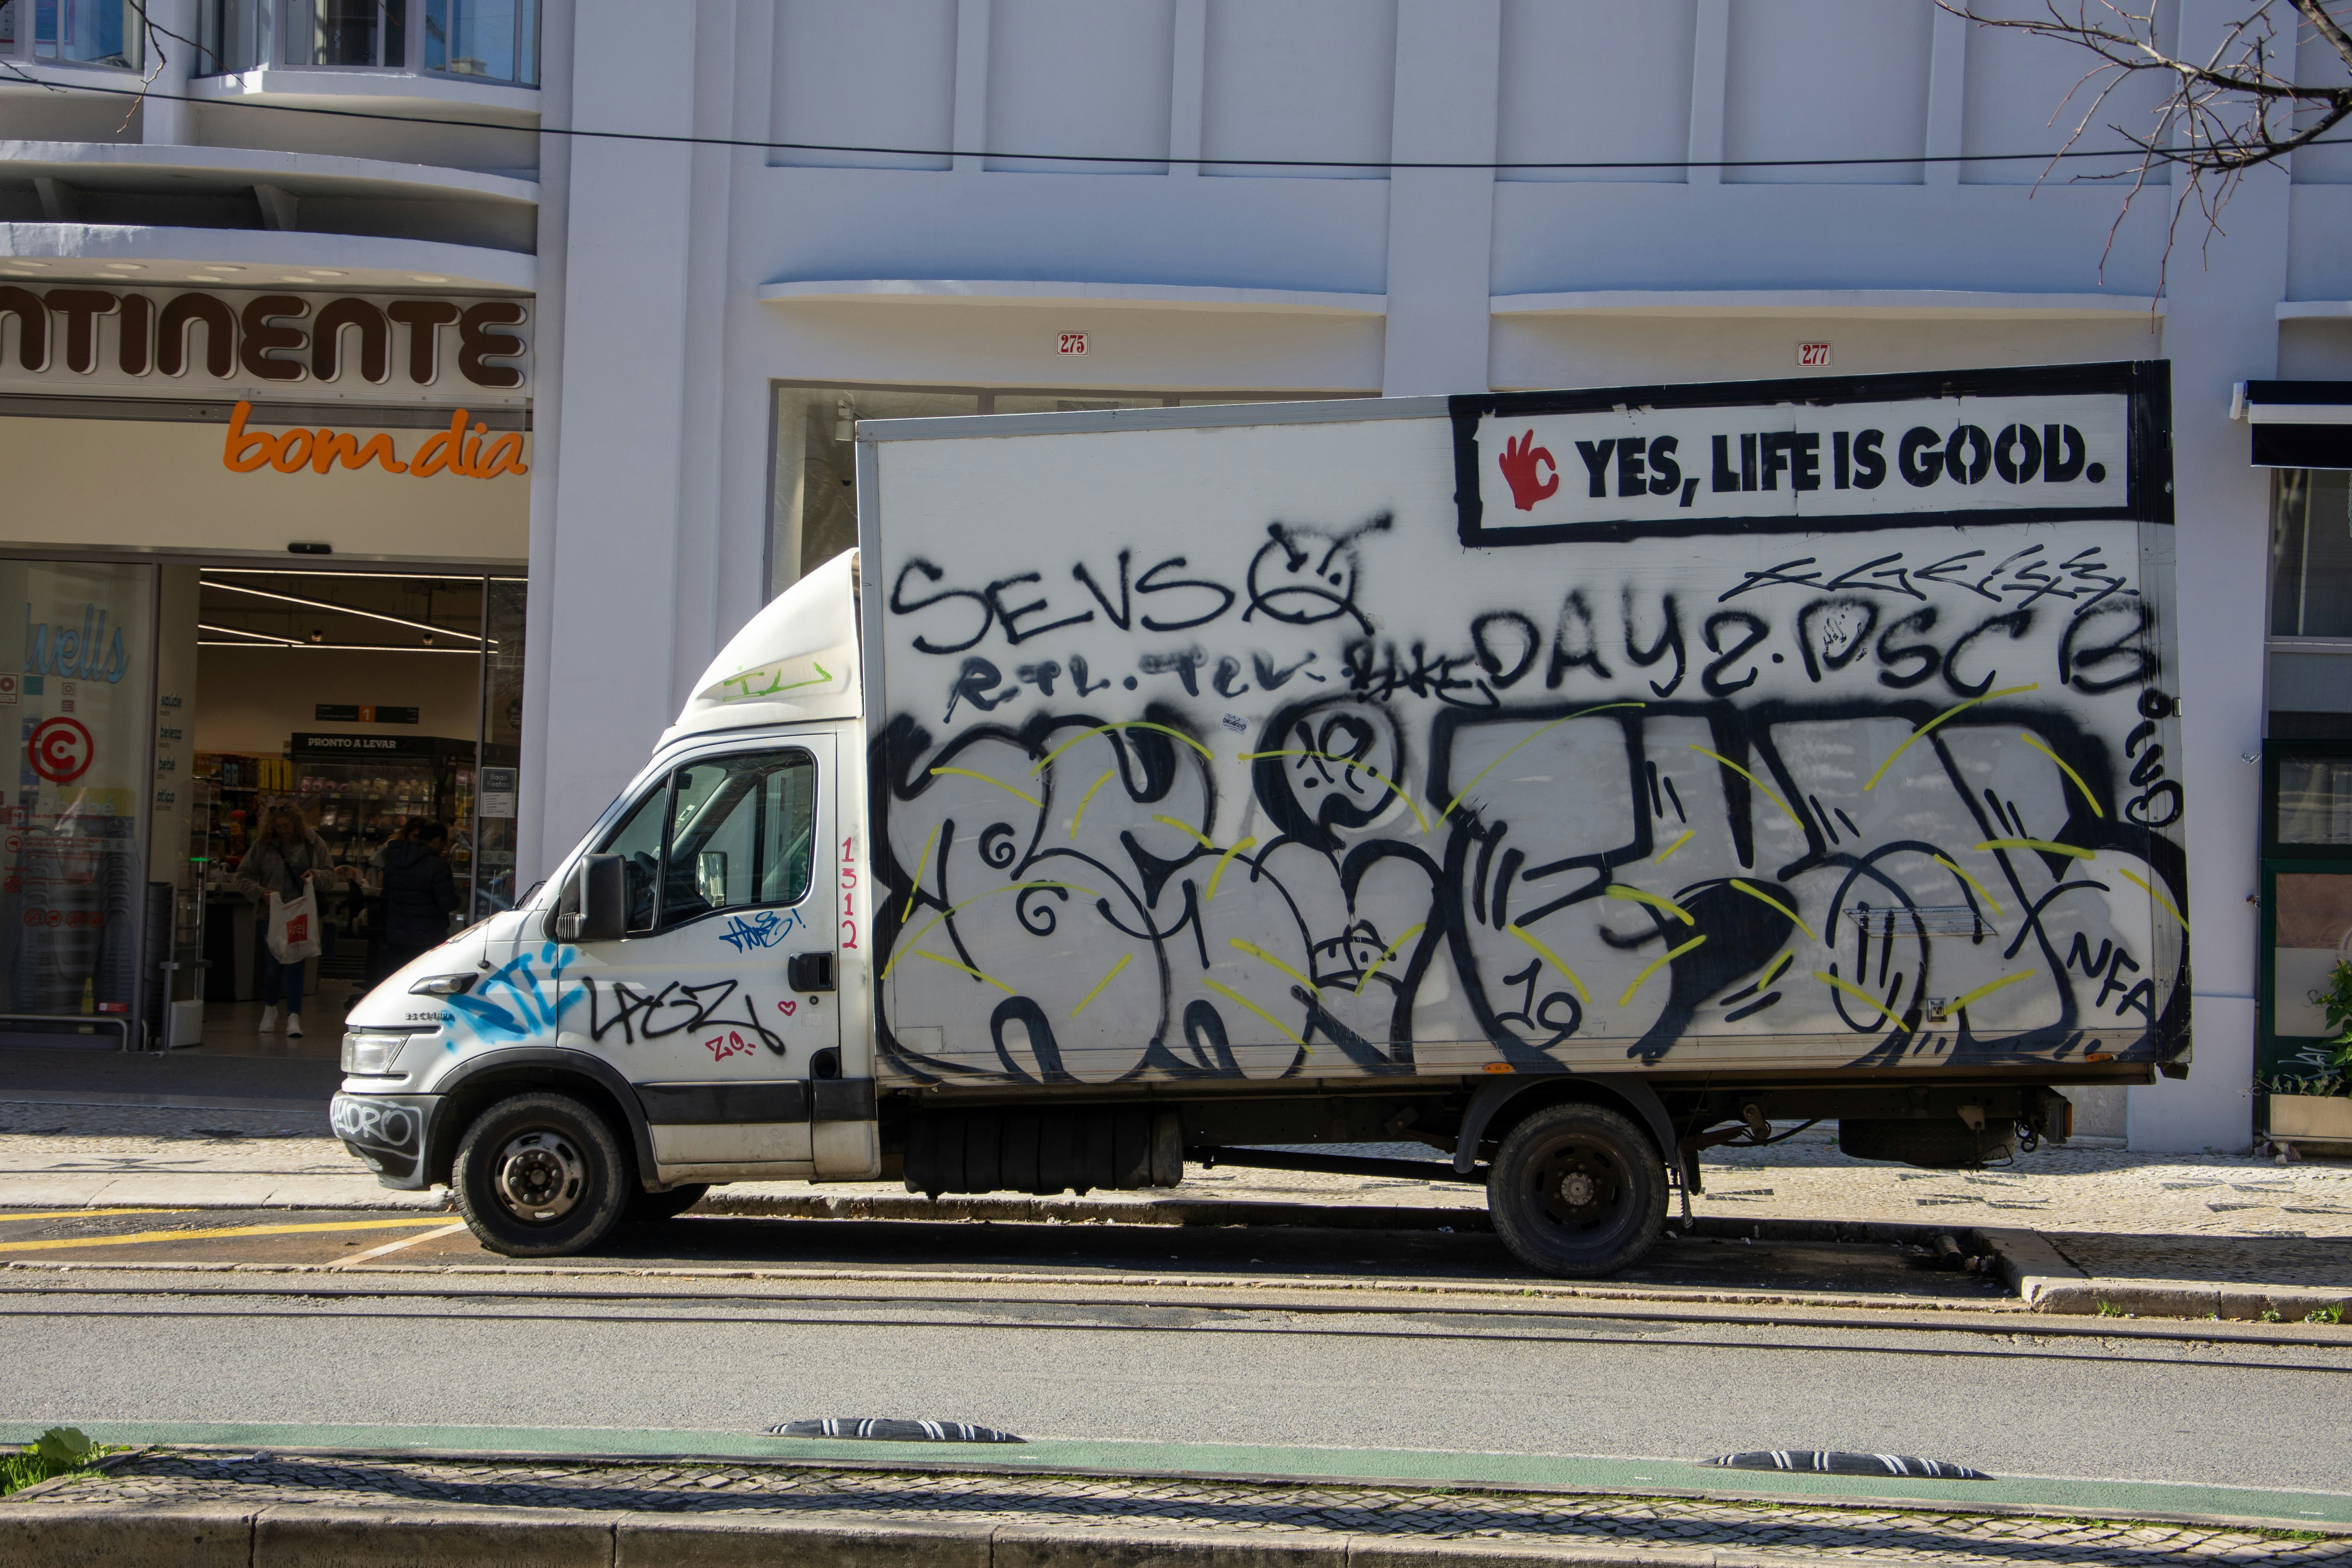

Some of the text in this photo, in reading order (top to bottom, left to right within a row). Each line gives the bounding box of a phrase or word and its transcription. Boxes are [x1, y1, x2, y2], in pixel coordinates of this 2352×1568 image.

[1061, 335, 1084, 353] 275
[1803, 345, 1828, 364] 277
[223, 401, 528, 478] bom dia
[1574, 424, 2107, 508] YES, LIFE IS GOOD.
[161, 692, 181, 708] saúde
[362, 708, 370, 721] 1
[159, 724, 181, 739] beleza
[308, 738, 351, 747] PRONTO
[363, 740, 396, 749] LEVAR
